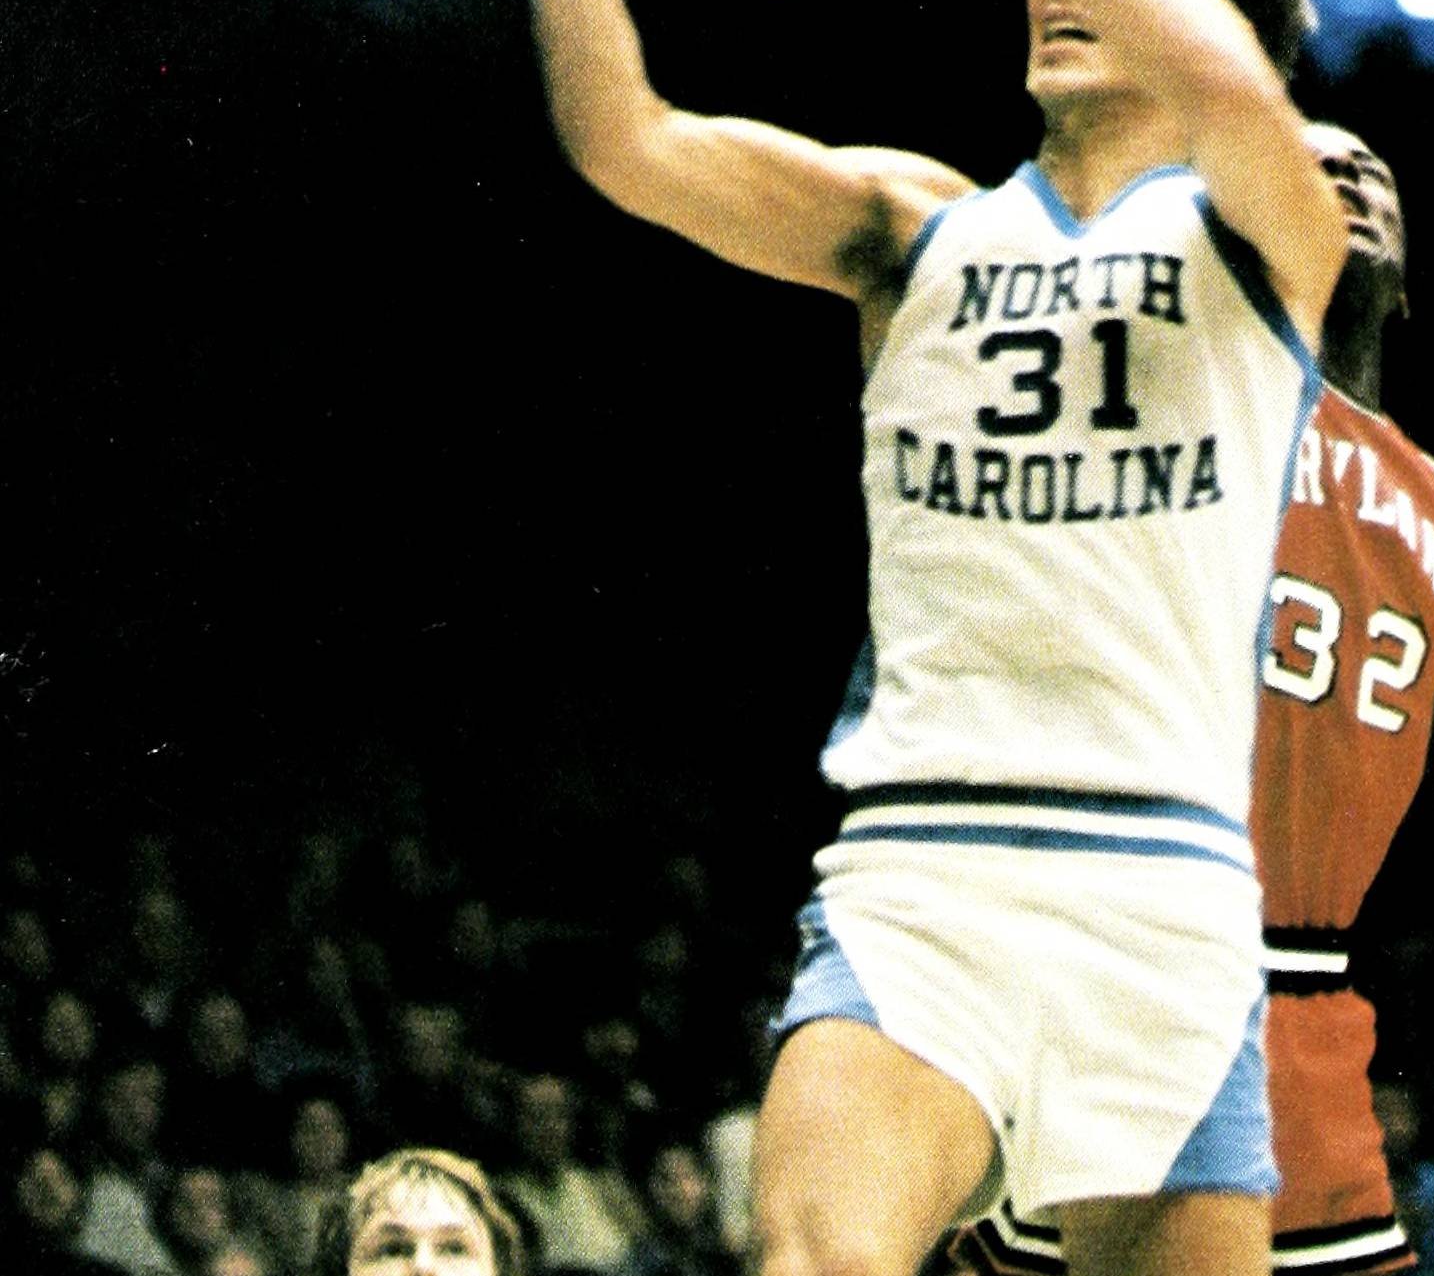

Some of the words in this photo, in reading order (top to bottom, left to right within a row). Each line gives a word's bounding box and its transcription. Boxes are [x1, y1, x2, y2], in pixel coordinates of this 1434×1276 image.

[948, 253, 1186, 331] NORTH
[976, 318, 1138, 437] 31
[894, 428, 1224, 523] CAROLINA
[1262, 574, 1427, 733] 32
